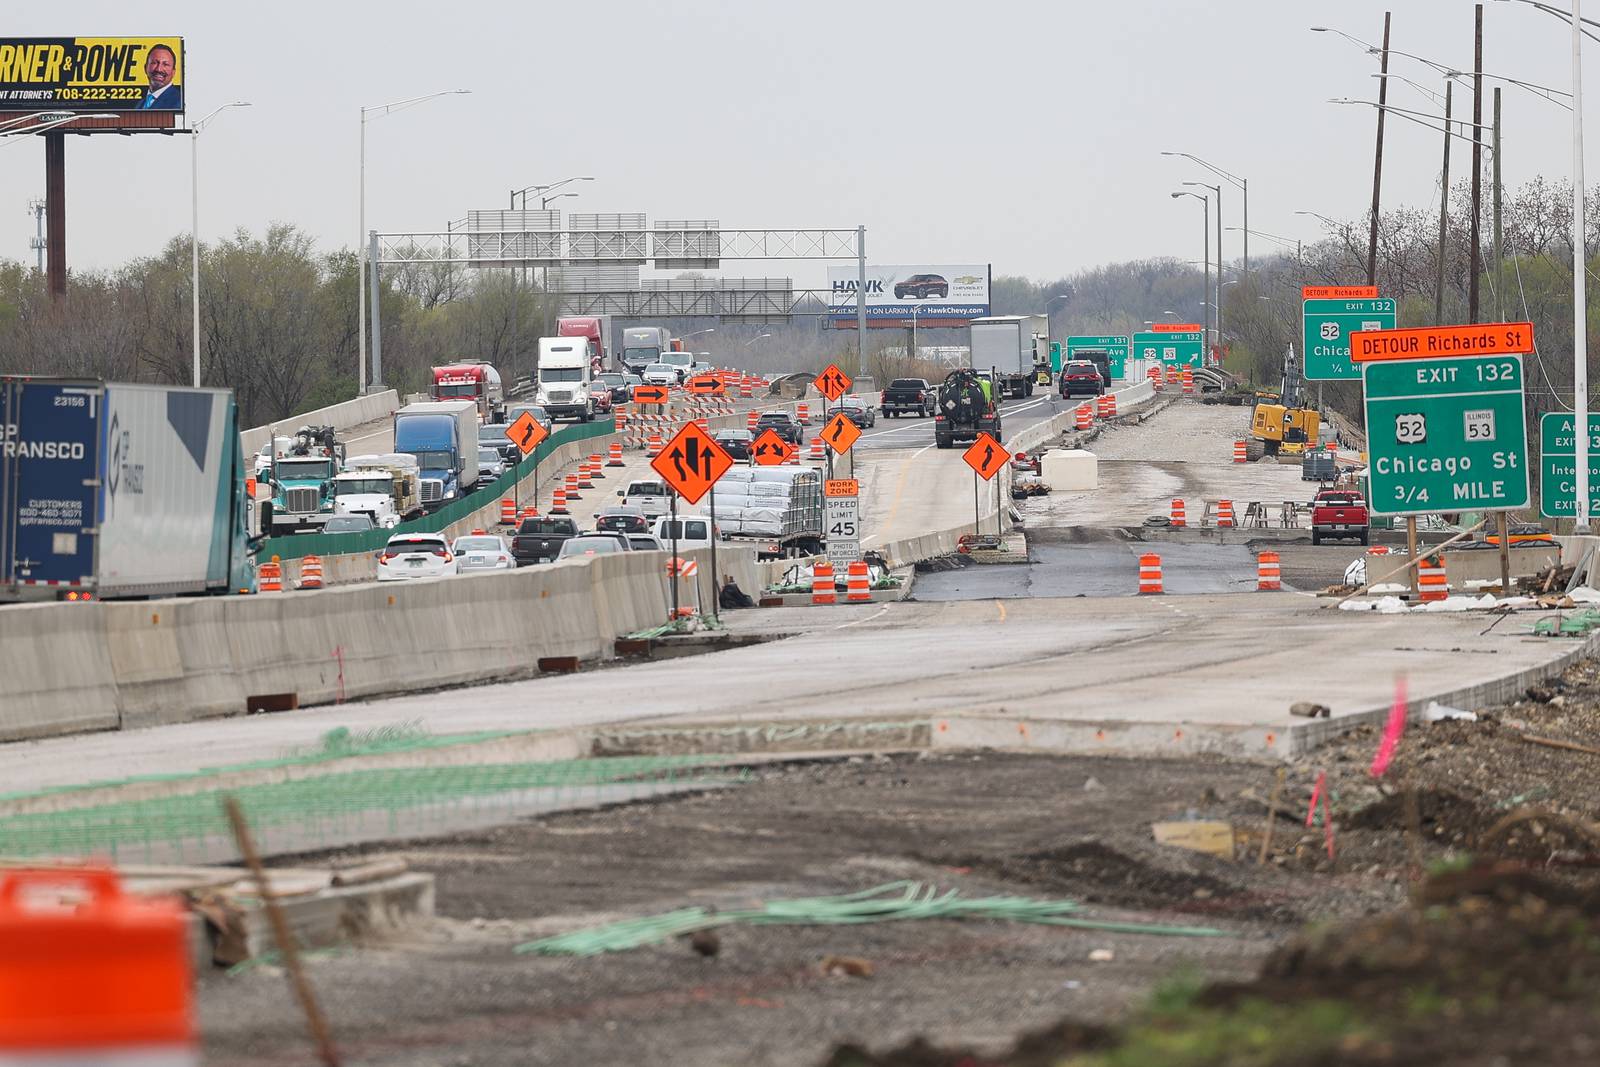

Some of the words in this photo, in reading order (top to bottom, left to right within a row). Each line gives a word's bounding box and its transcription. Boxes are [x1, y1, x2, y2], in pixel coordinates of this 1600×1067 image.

[0, 44, 64, 82] RNER
[73, 44, 142, 82] ROWE
[9, 90, 53, 100] ATTORNEYS
[55, 88, 142, 100] 708-222-2222
[1306, 289, 1329, 297] DETOUR
[1335, 289, 1363, 297] Richards
[1366, 288, 1374, 296] St
[928, 307, 984, 315] HawkChevy.com
[1370, 302, 1391, 311] 132
[1322, 326, 1339, 337] 52
[1363, 336, 1419, 355] DETOUR
[1428, 333, 1496, 351] Richards
[1505, 331, 1522, 347] St
[1109, 348, 1124, 356] Ave
[1144, 349, 1156, 358] 52
[1165, 351, 1174, 359] 53
[1314, 345, 1350, 356] Chica
[1417, 367, 1458, 384] EXIT
[1476, 363, 1514, 382] 132
[1467, 412, 1491, 420] ILLINOIS
[1399, 421, 1423, 437] 52
[1469, 423, 1491, 438] 53
[1555, 437, 1576, 447] EXI
[0, 441, 84, 459] RANSCO
[1376, 455, 1472, 477] Chicago
[1492, 451, 1517, 469] St
[1394, 485, 1429, 504] 3/4
[1453, 480, 1506, 501] MILE
[29, 499, 82, 509] CUSTOMERS
[830, 522, 855, 536] 45
